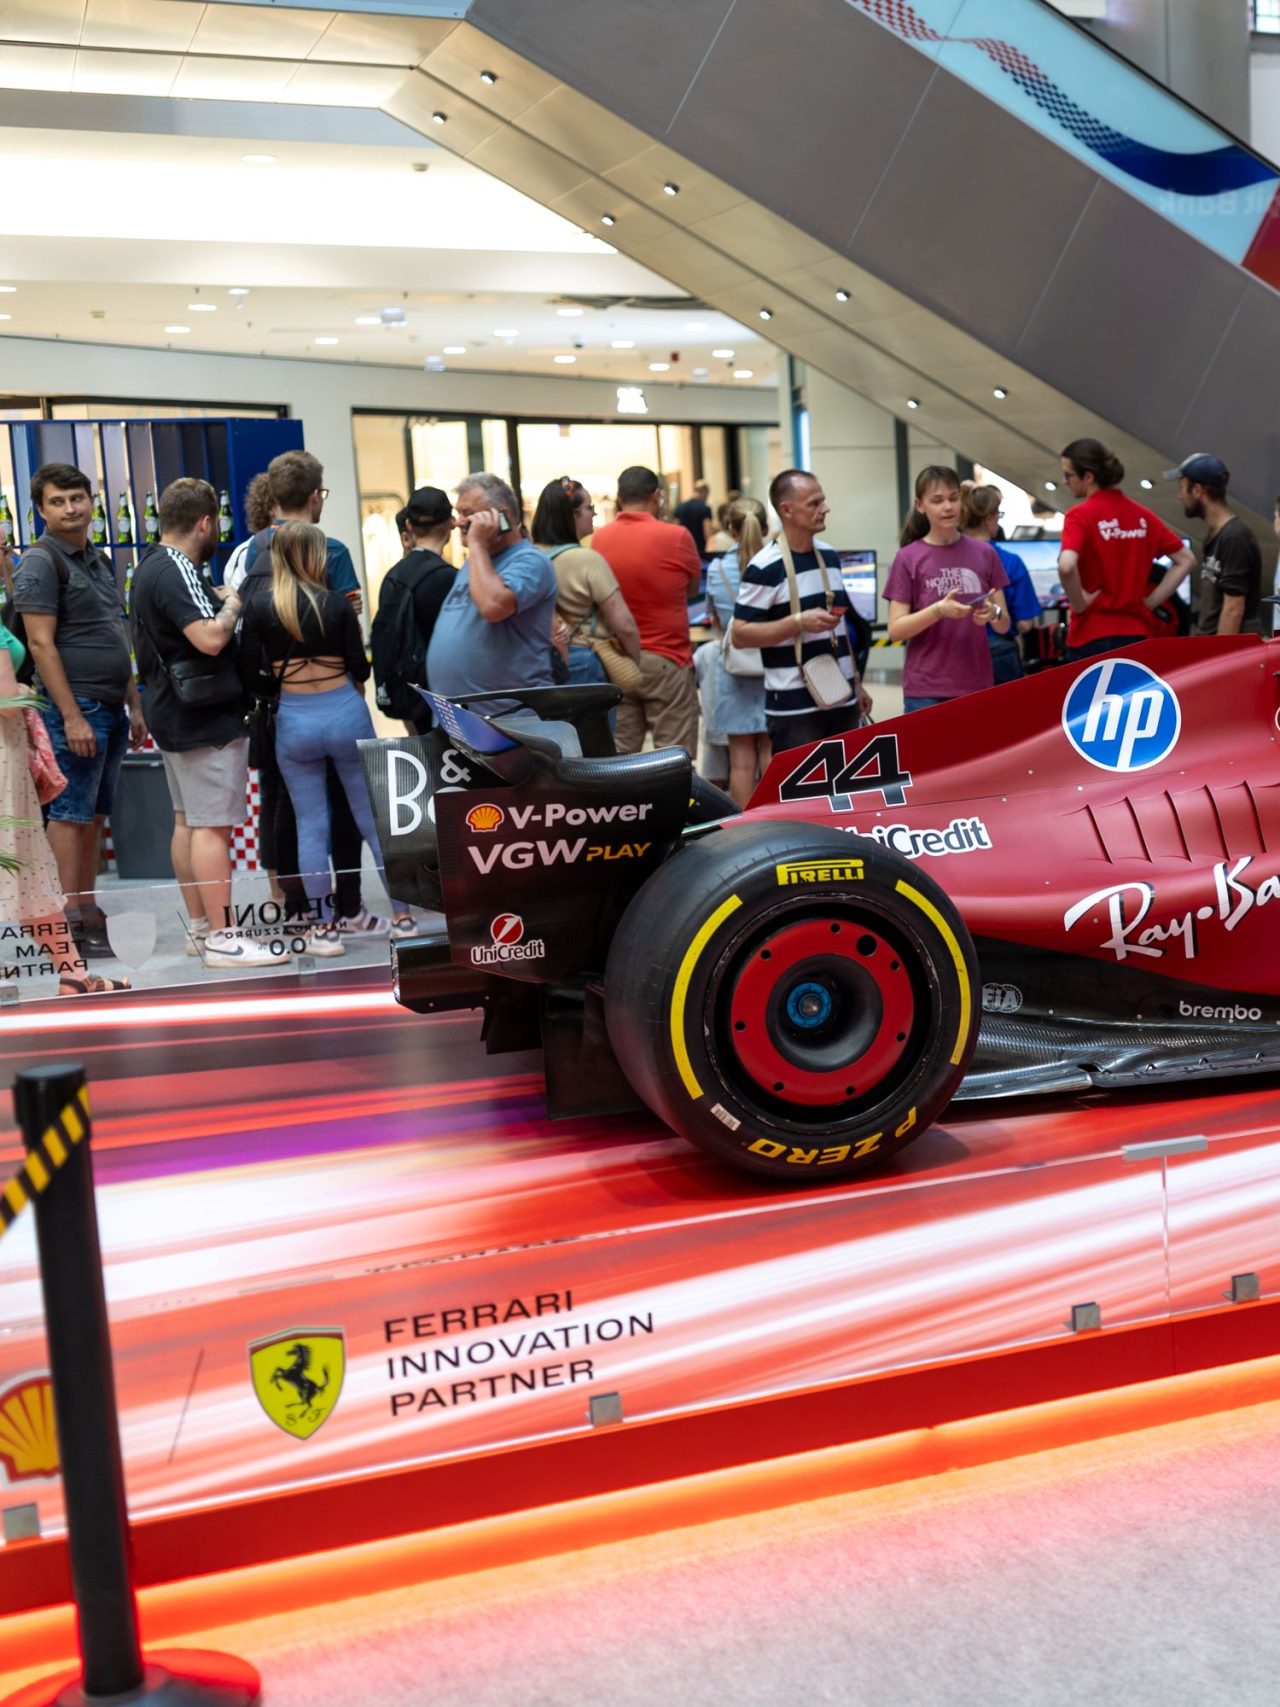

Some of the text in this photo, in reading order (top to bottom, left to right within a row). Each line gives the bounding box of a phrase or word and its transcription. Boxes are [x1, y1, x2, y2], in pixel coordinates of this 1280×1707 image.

[1100, 527, 1147, 541] V-Power
[925, 576, 962, 590] NORTH
[939, 567, 961, 578] THE
[1080, 659, 1167, 771] hp
[778, 734, 914, 813] 44
[507, 803, 653, 830] V-Power
[848, 816, 990, 857] iCredit
[467, 837, 652, 875] VGW PLAY
[775, 859, 865, 886] PIRELLI
[471, 939, 545, 965] UniCredit
[1178, 1001, 1262, 1020] brembo
[746, 1106, 918, 1166] P ZERO
[383, 1289, 574, 1344] FERRARI
[387, 1311, 655, 1380] INNOVATION
[389, 1359, 595, 1418] PARTNER
